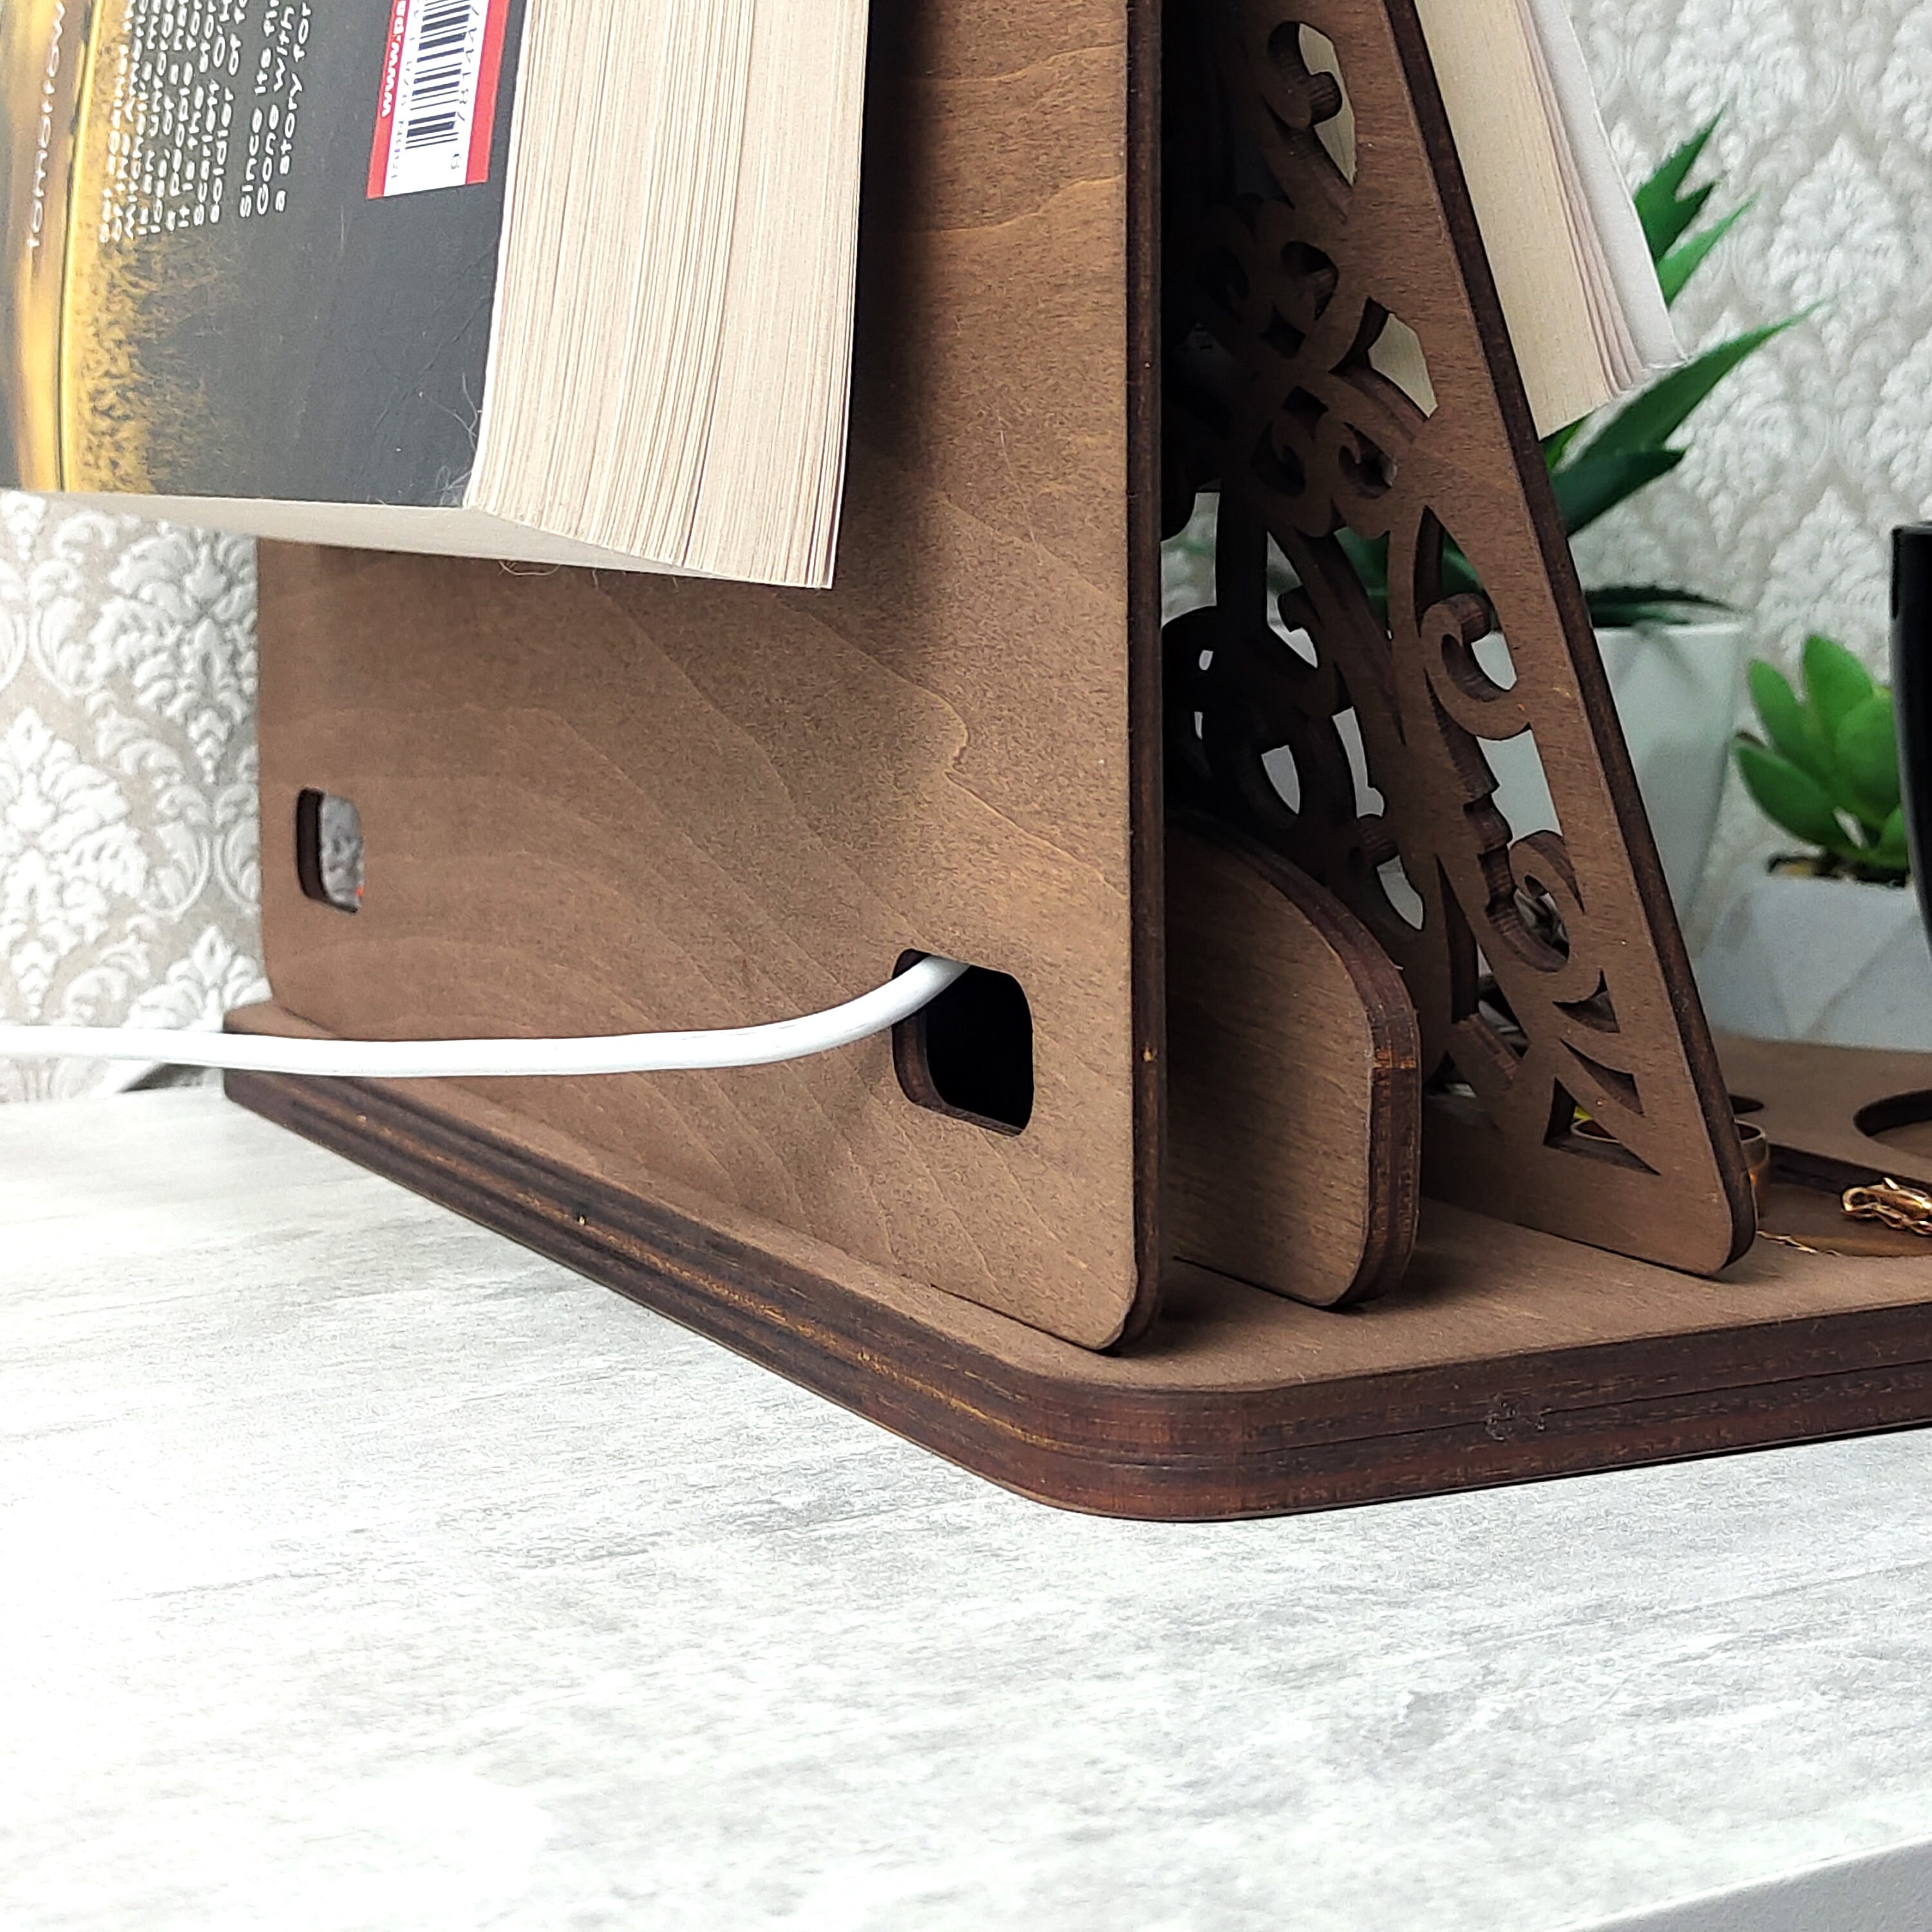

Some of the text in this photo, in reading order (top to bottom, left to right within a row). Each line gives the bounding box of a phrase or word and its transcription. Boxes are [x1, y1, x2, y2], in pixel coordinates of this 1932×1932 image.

[26, 1, 66, 249] tomorrow
[107, 44, 129, 175] against
[115, 133, 130, 193] the
[124, 61, 152, 240] Mitchell's
[150, 148, 170, 234] loss,
[163, 95, 175, 135] of
[170, 64, 179, 85] a
[169, 61, 193, 196] people
[182, 160, 195, 191] is
[187, 85, 204, 151] the
[193, 79, 220, 226] Scarlett
[210, 87, 234, 223] soldier
[229, 33, 242, 75] of
[240, 108, 262, 218] Since
[254, 47, 271, 95] its
[257, 6, 294, 215] Gone with
[275, 2, 311, 212] a story for
[111, 203, 123, 242] of
[136, 207, 148, 234] is
[143, 150, 155, 194] an
[166, 210, 176, 231] a
